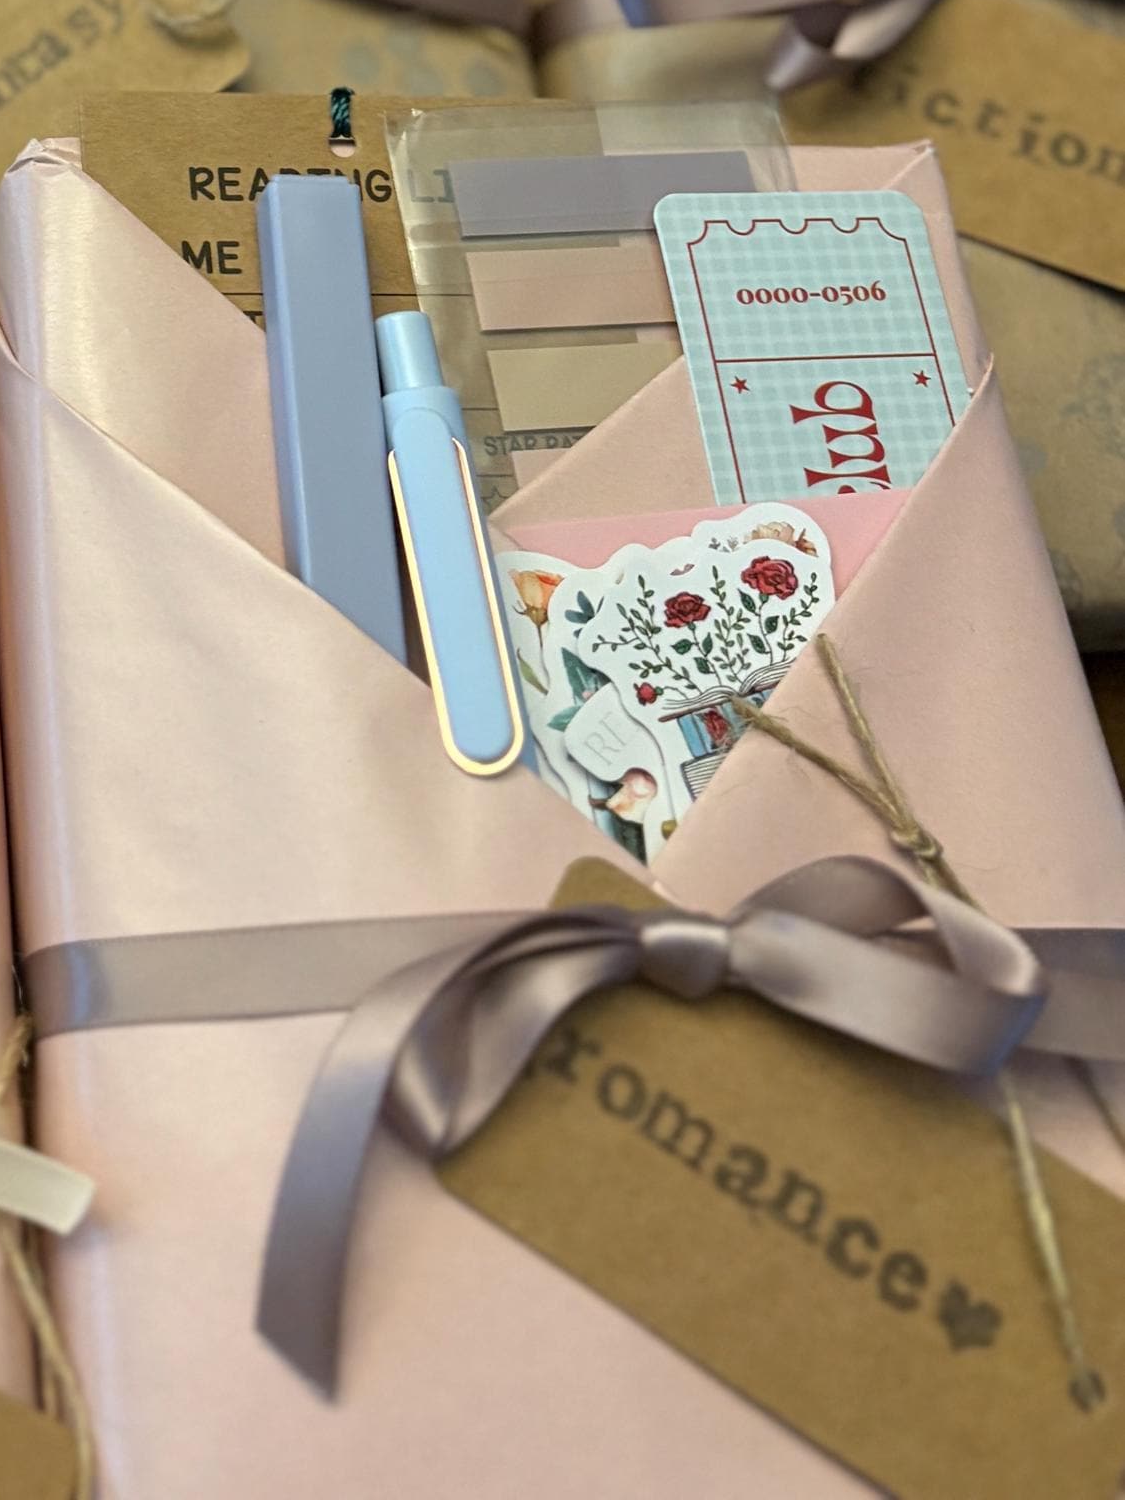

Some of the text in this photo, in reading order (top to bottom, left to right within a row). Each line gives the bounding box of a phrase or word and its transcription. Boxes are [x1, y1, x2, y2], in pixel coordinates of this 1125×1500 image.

[736, 280, 887, 306] 0000-0506
[789, 380, 892, 495] lub
[543, 1012, 929, 1312] romance
